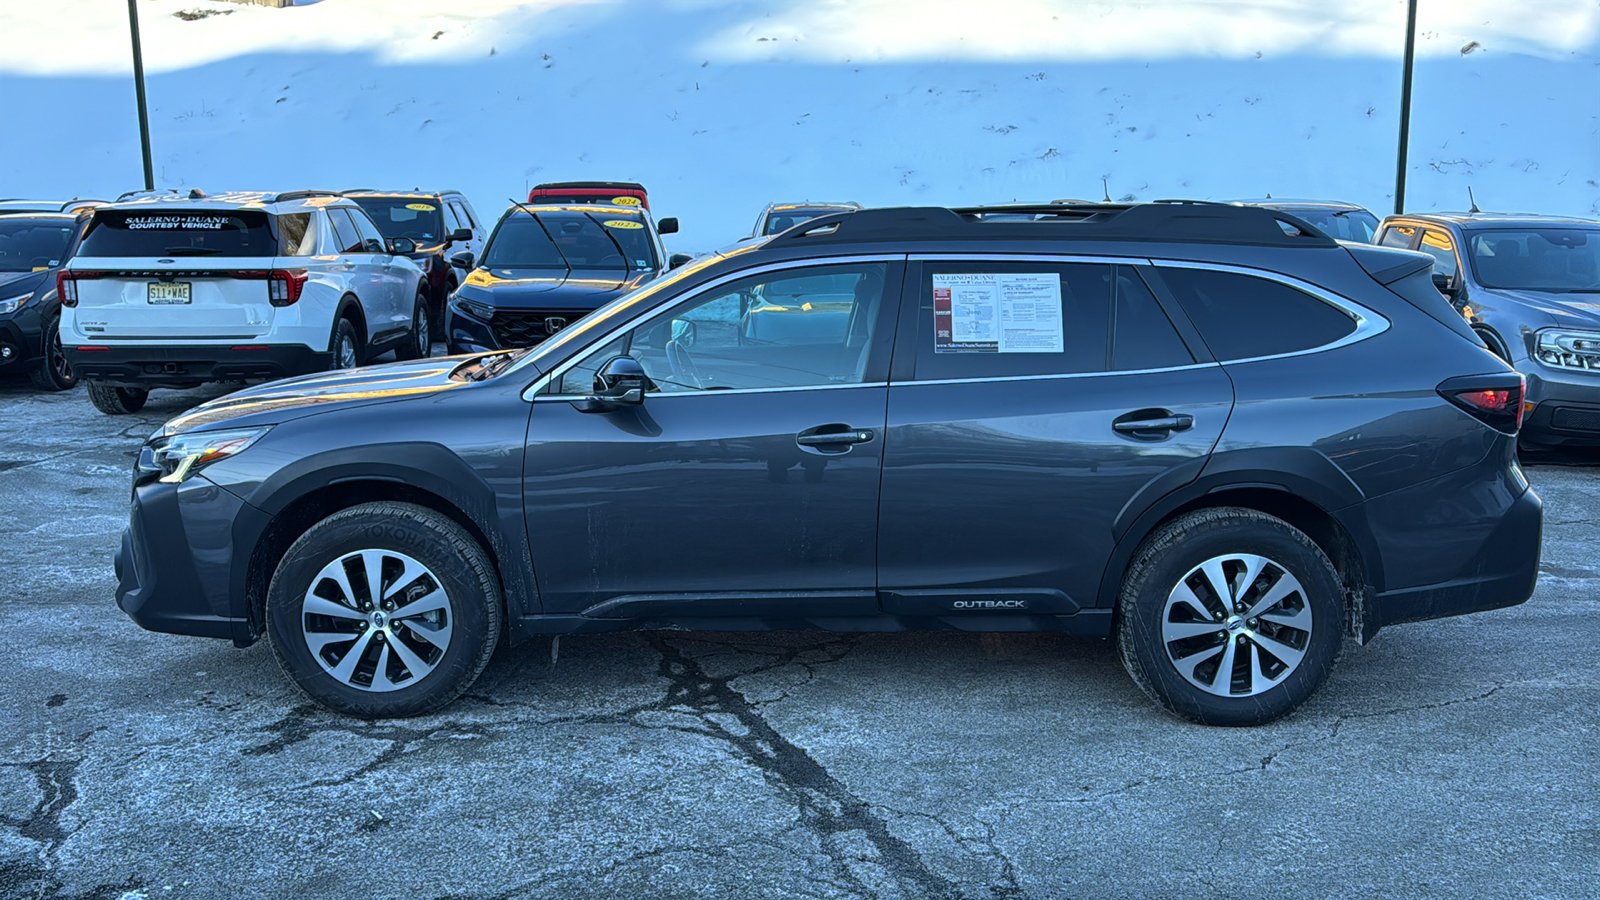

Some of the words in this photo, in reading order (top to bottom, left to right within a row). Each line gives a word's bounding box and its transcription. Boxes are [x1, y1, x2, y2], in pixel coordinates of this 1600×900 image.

[125, 216, 180, 224] SALERNO
[186, 216, 229, 224] DUANE
[364, 524, 449, 567] YOKOHAMA
[953, 600, 1025, 608] OUTBACK
